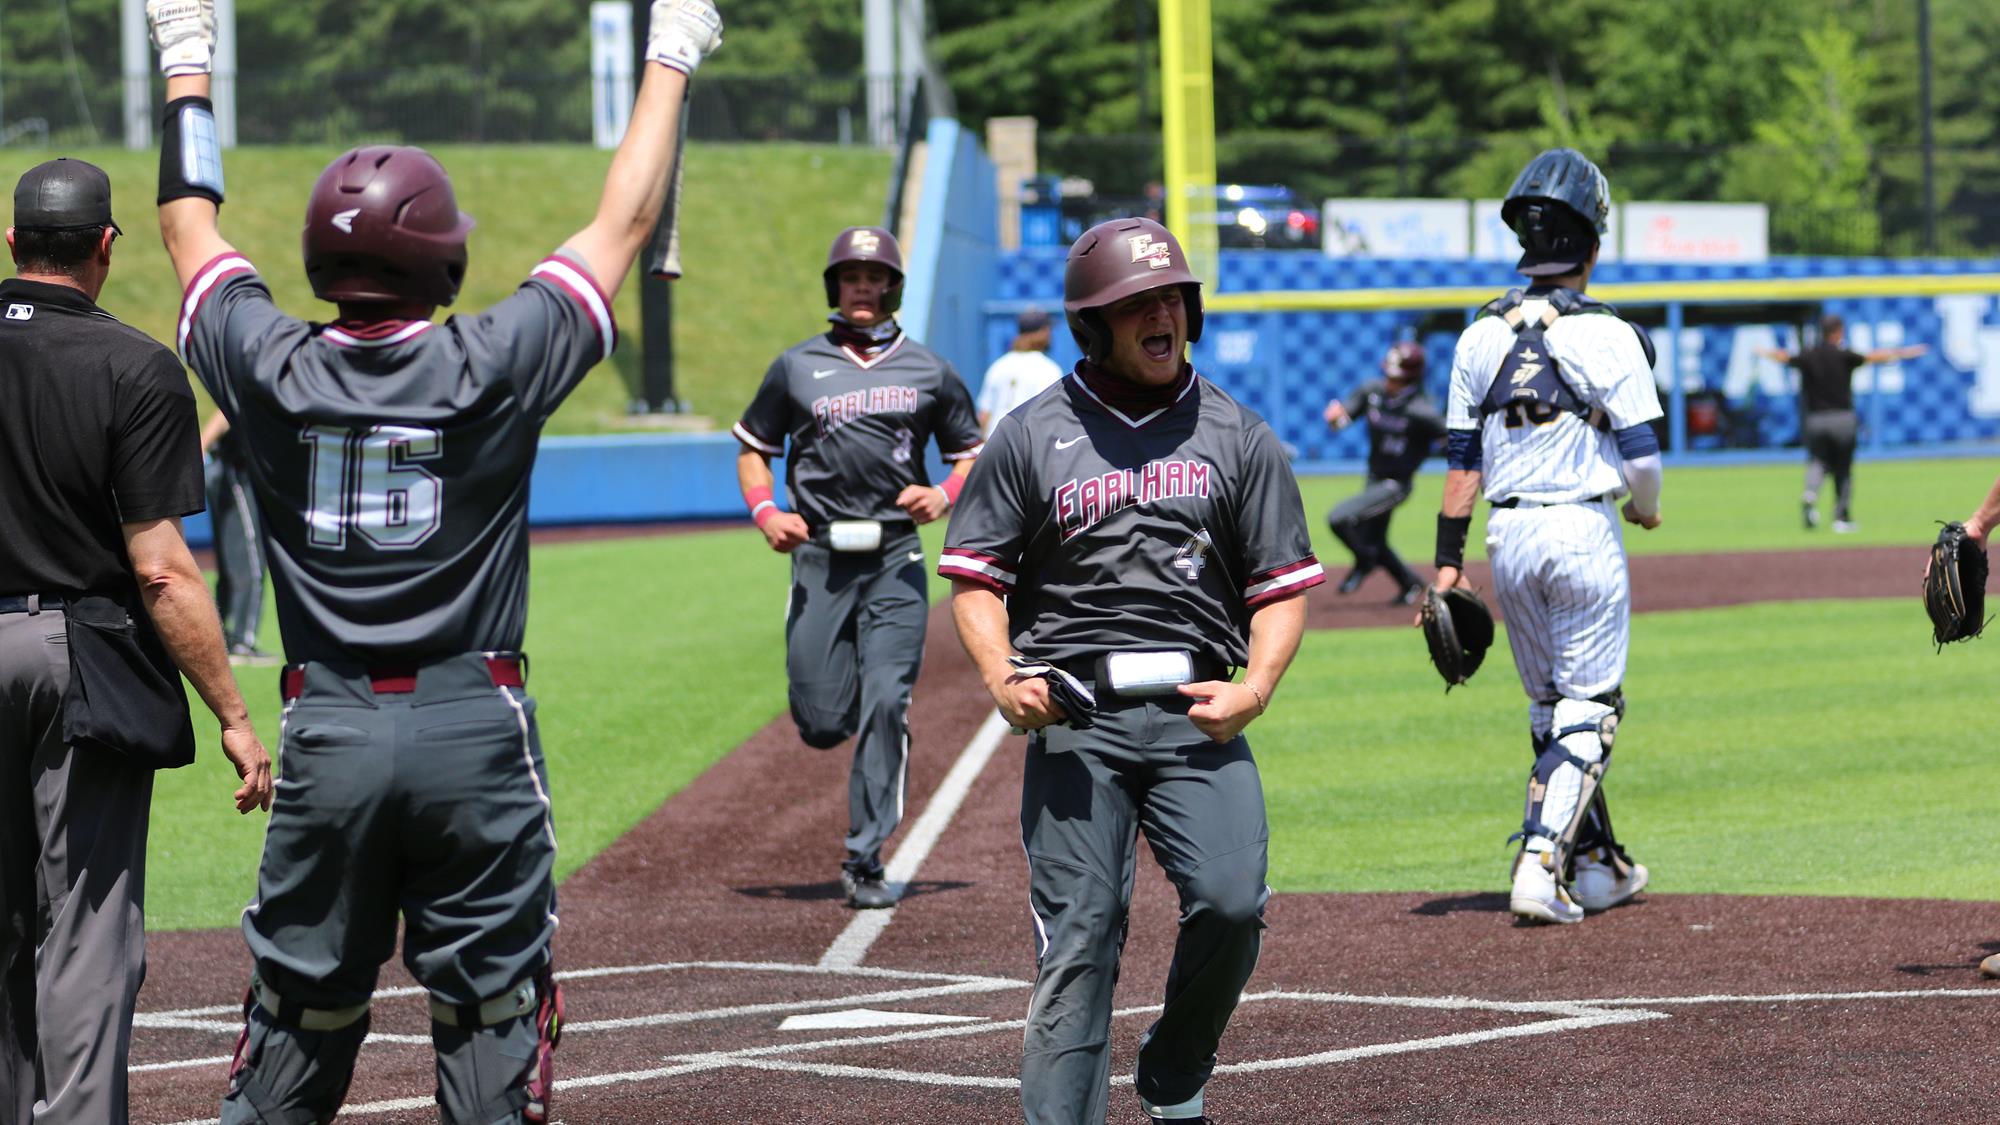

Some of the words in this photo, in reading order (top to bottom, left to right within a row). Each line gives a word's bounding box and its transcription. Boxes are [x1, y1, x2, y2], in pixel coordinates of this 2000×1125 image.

[1127, 233, 1171, 270] EC
[811, 385, 918, 441] EARLHAM
[298, 424, 443, 551] 16
[1055, 459, 1211, 546] EARLHAM
[1173, 527, 1213, 581] 4
